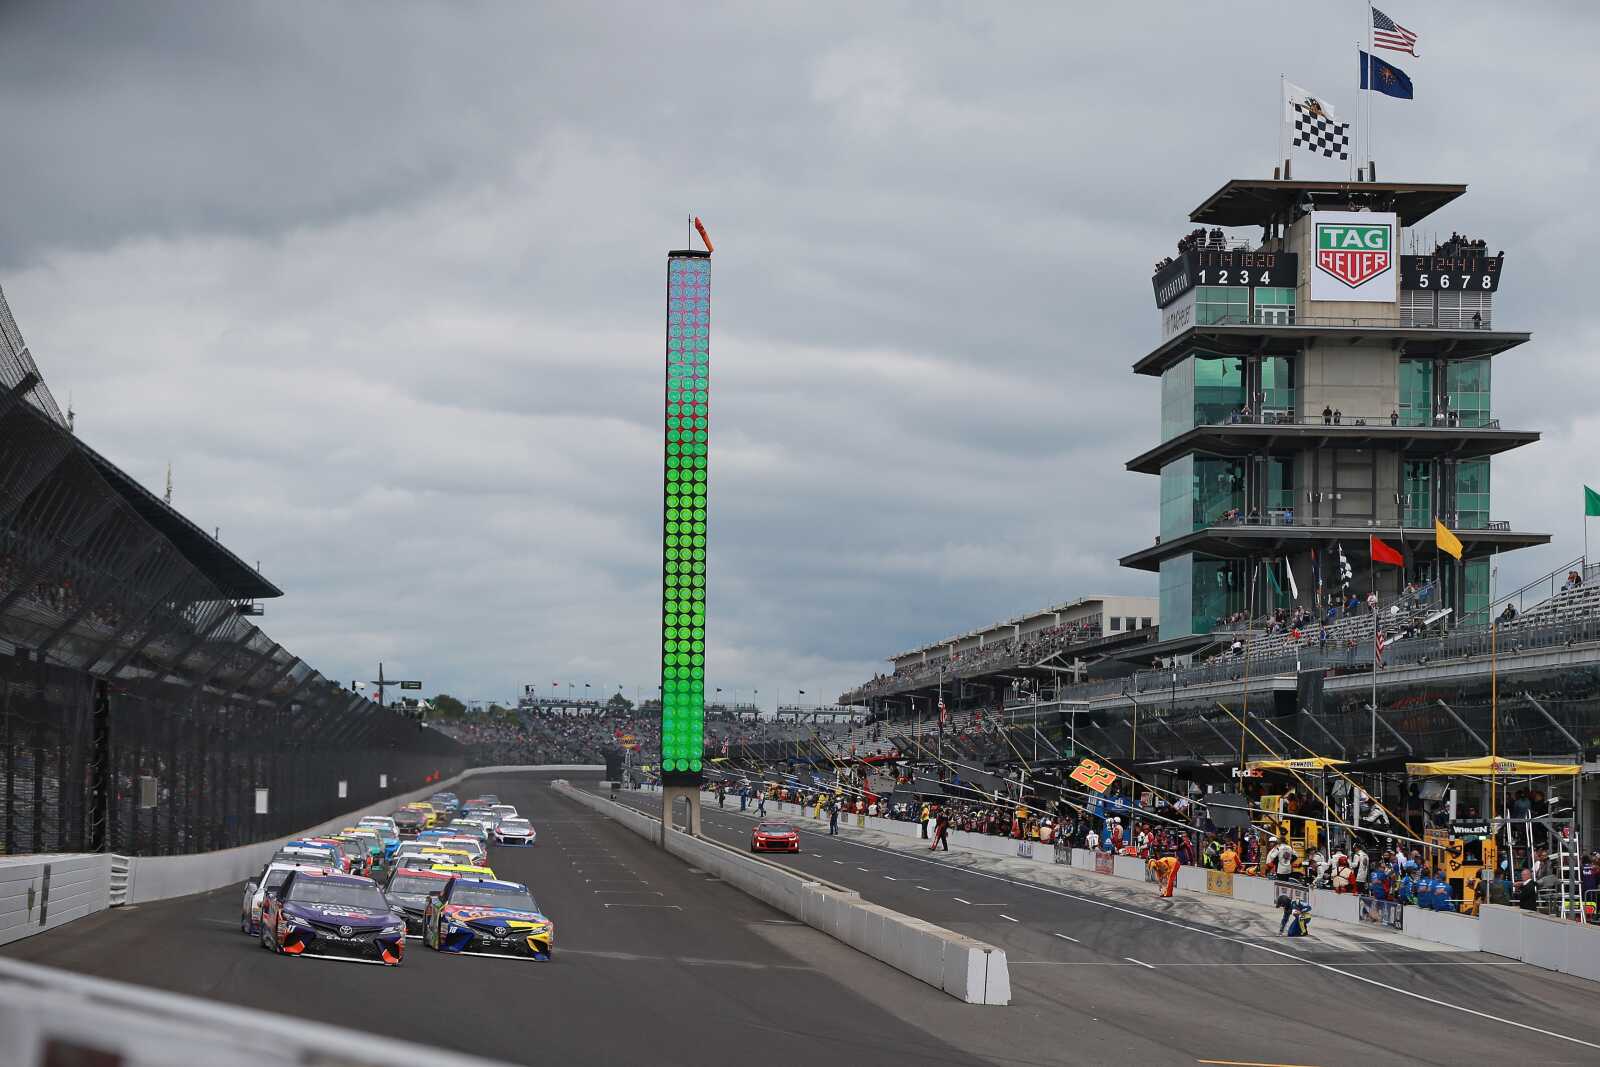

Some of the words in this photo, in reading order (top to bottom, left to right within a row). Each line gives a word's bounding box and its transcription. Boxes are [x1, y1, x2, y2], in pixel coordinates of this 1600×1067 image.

[1323, 229, 1384, 248] TAG
[1320, 251, 1386, 282] HEUER
[1198, 269, 1206, 284] 1
[1218, 270, 1228, 284] 2
[1239, 270, 1249, 284] 3
[1260, 270, 1270, 285] 4
[1419, 274, 1429, 288] 5
[1440, 274, 1450, 288] 6
[1461, 275, 1470, 289] 7
[1482, 275, 1491, 289] 8
[1069, 758, 1117, 794] 22
[1232, 767, 1264, 778] FedEx
